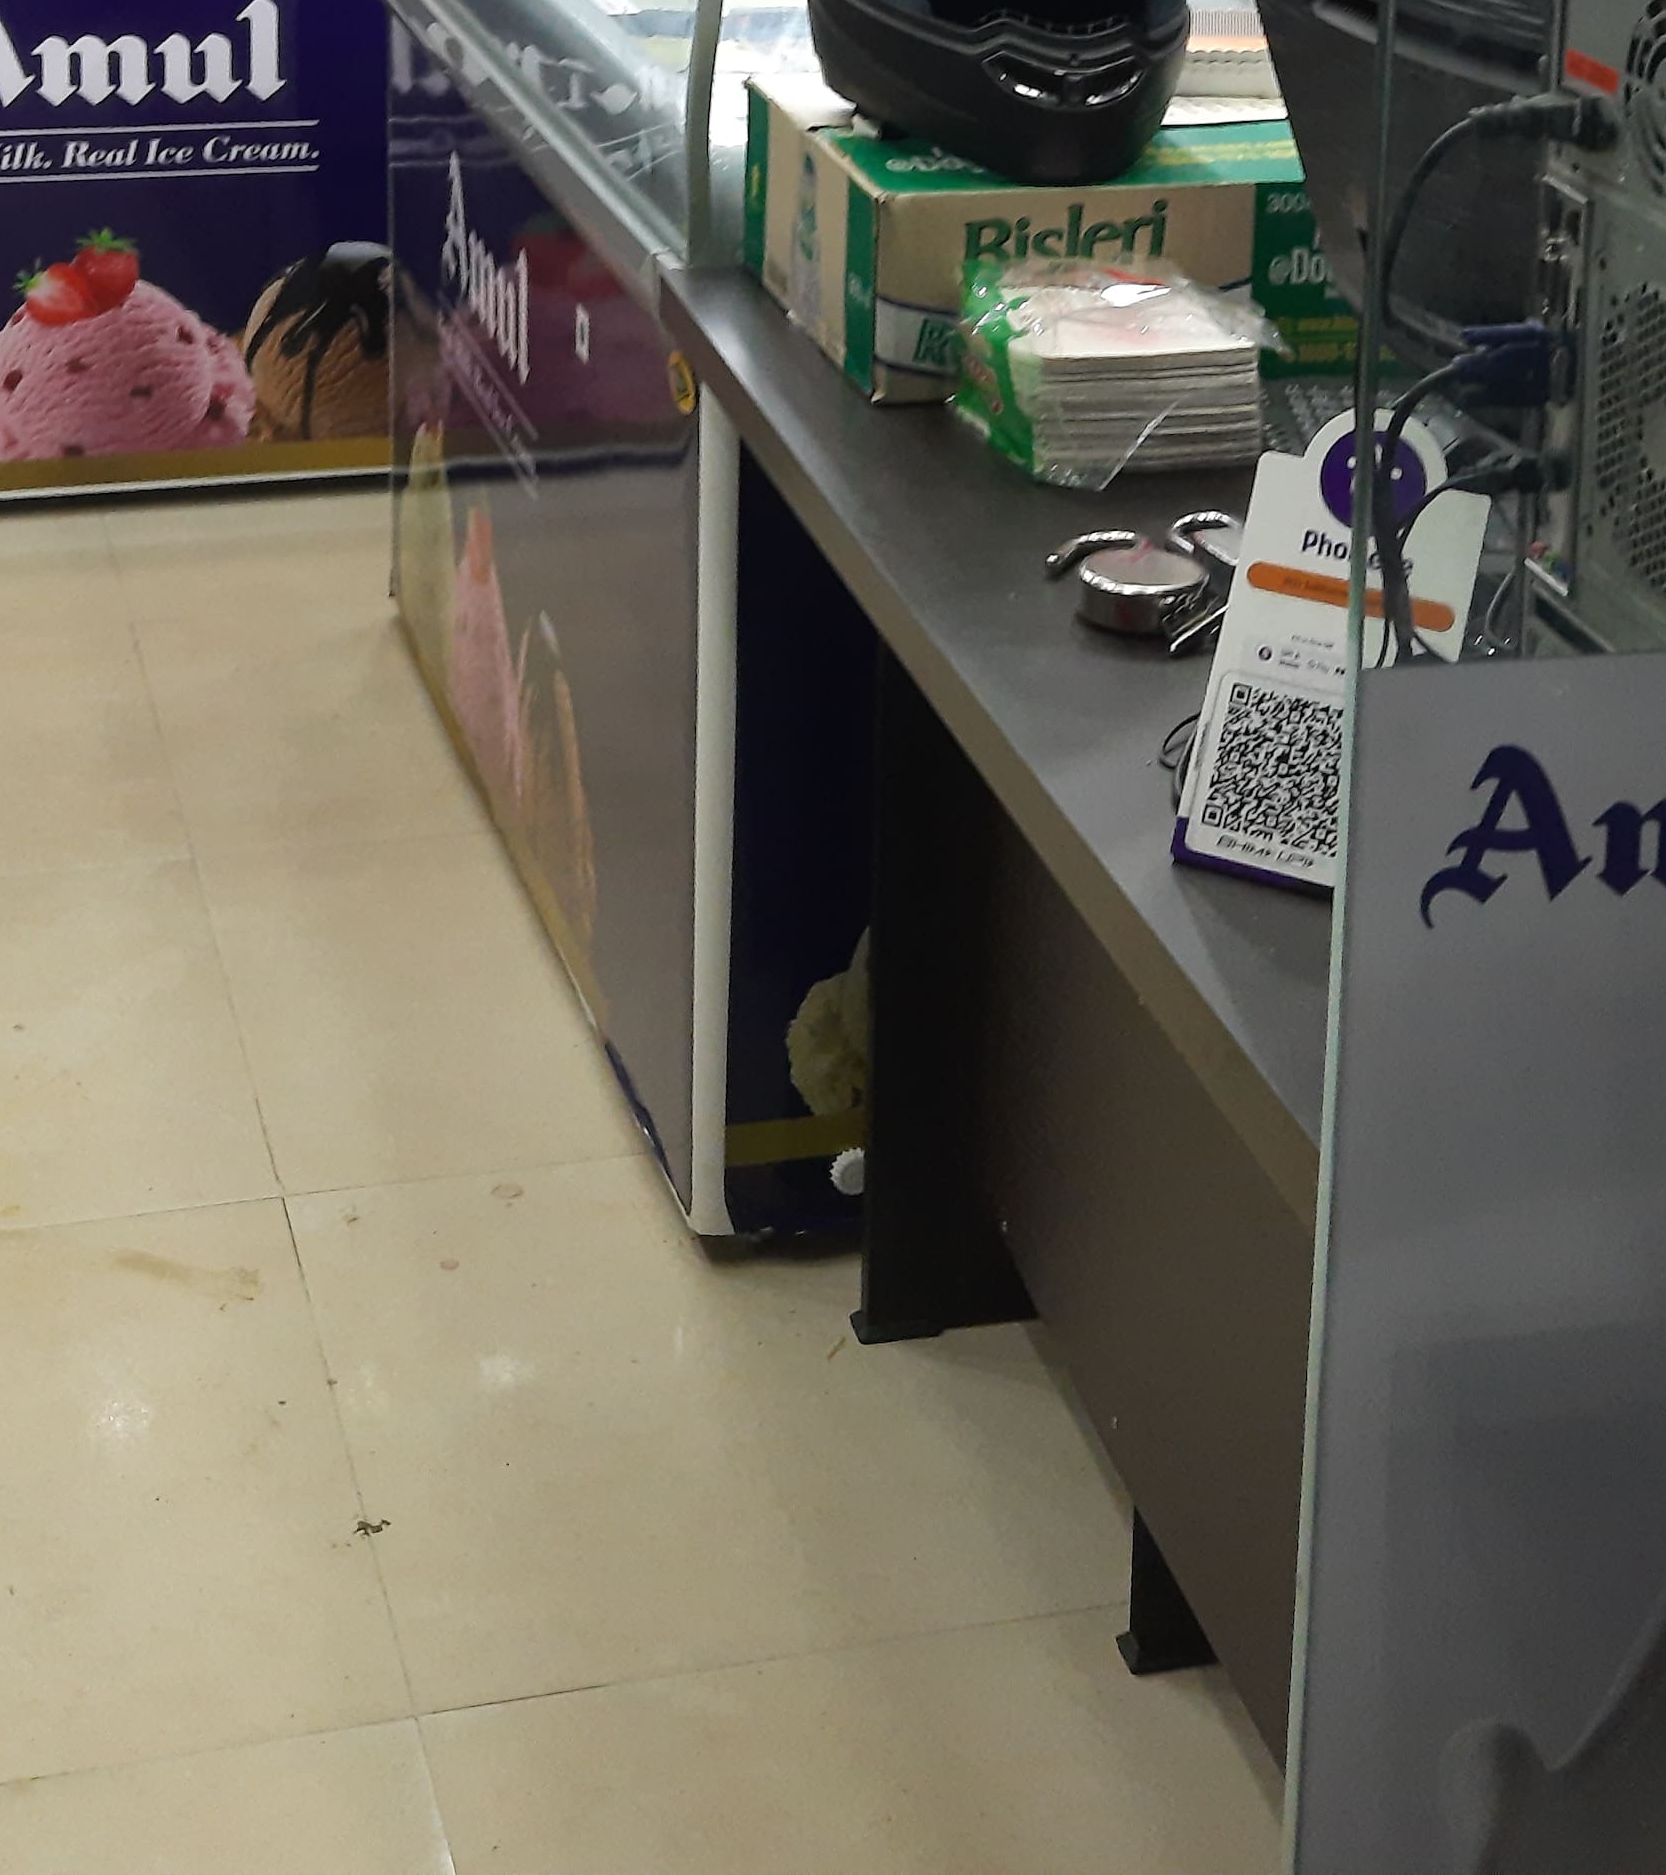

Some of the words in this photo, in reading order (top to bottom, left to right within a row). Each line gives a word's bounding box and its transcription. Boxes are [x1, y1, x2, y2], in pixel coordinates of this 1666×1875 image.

[60, 137, 139, 170] Real
[144, 136, 194, 167] Ice
[200, 134, 321, 164] Cream.
[442, 149, 530, 387] Amul
